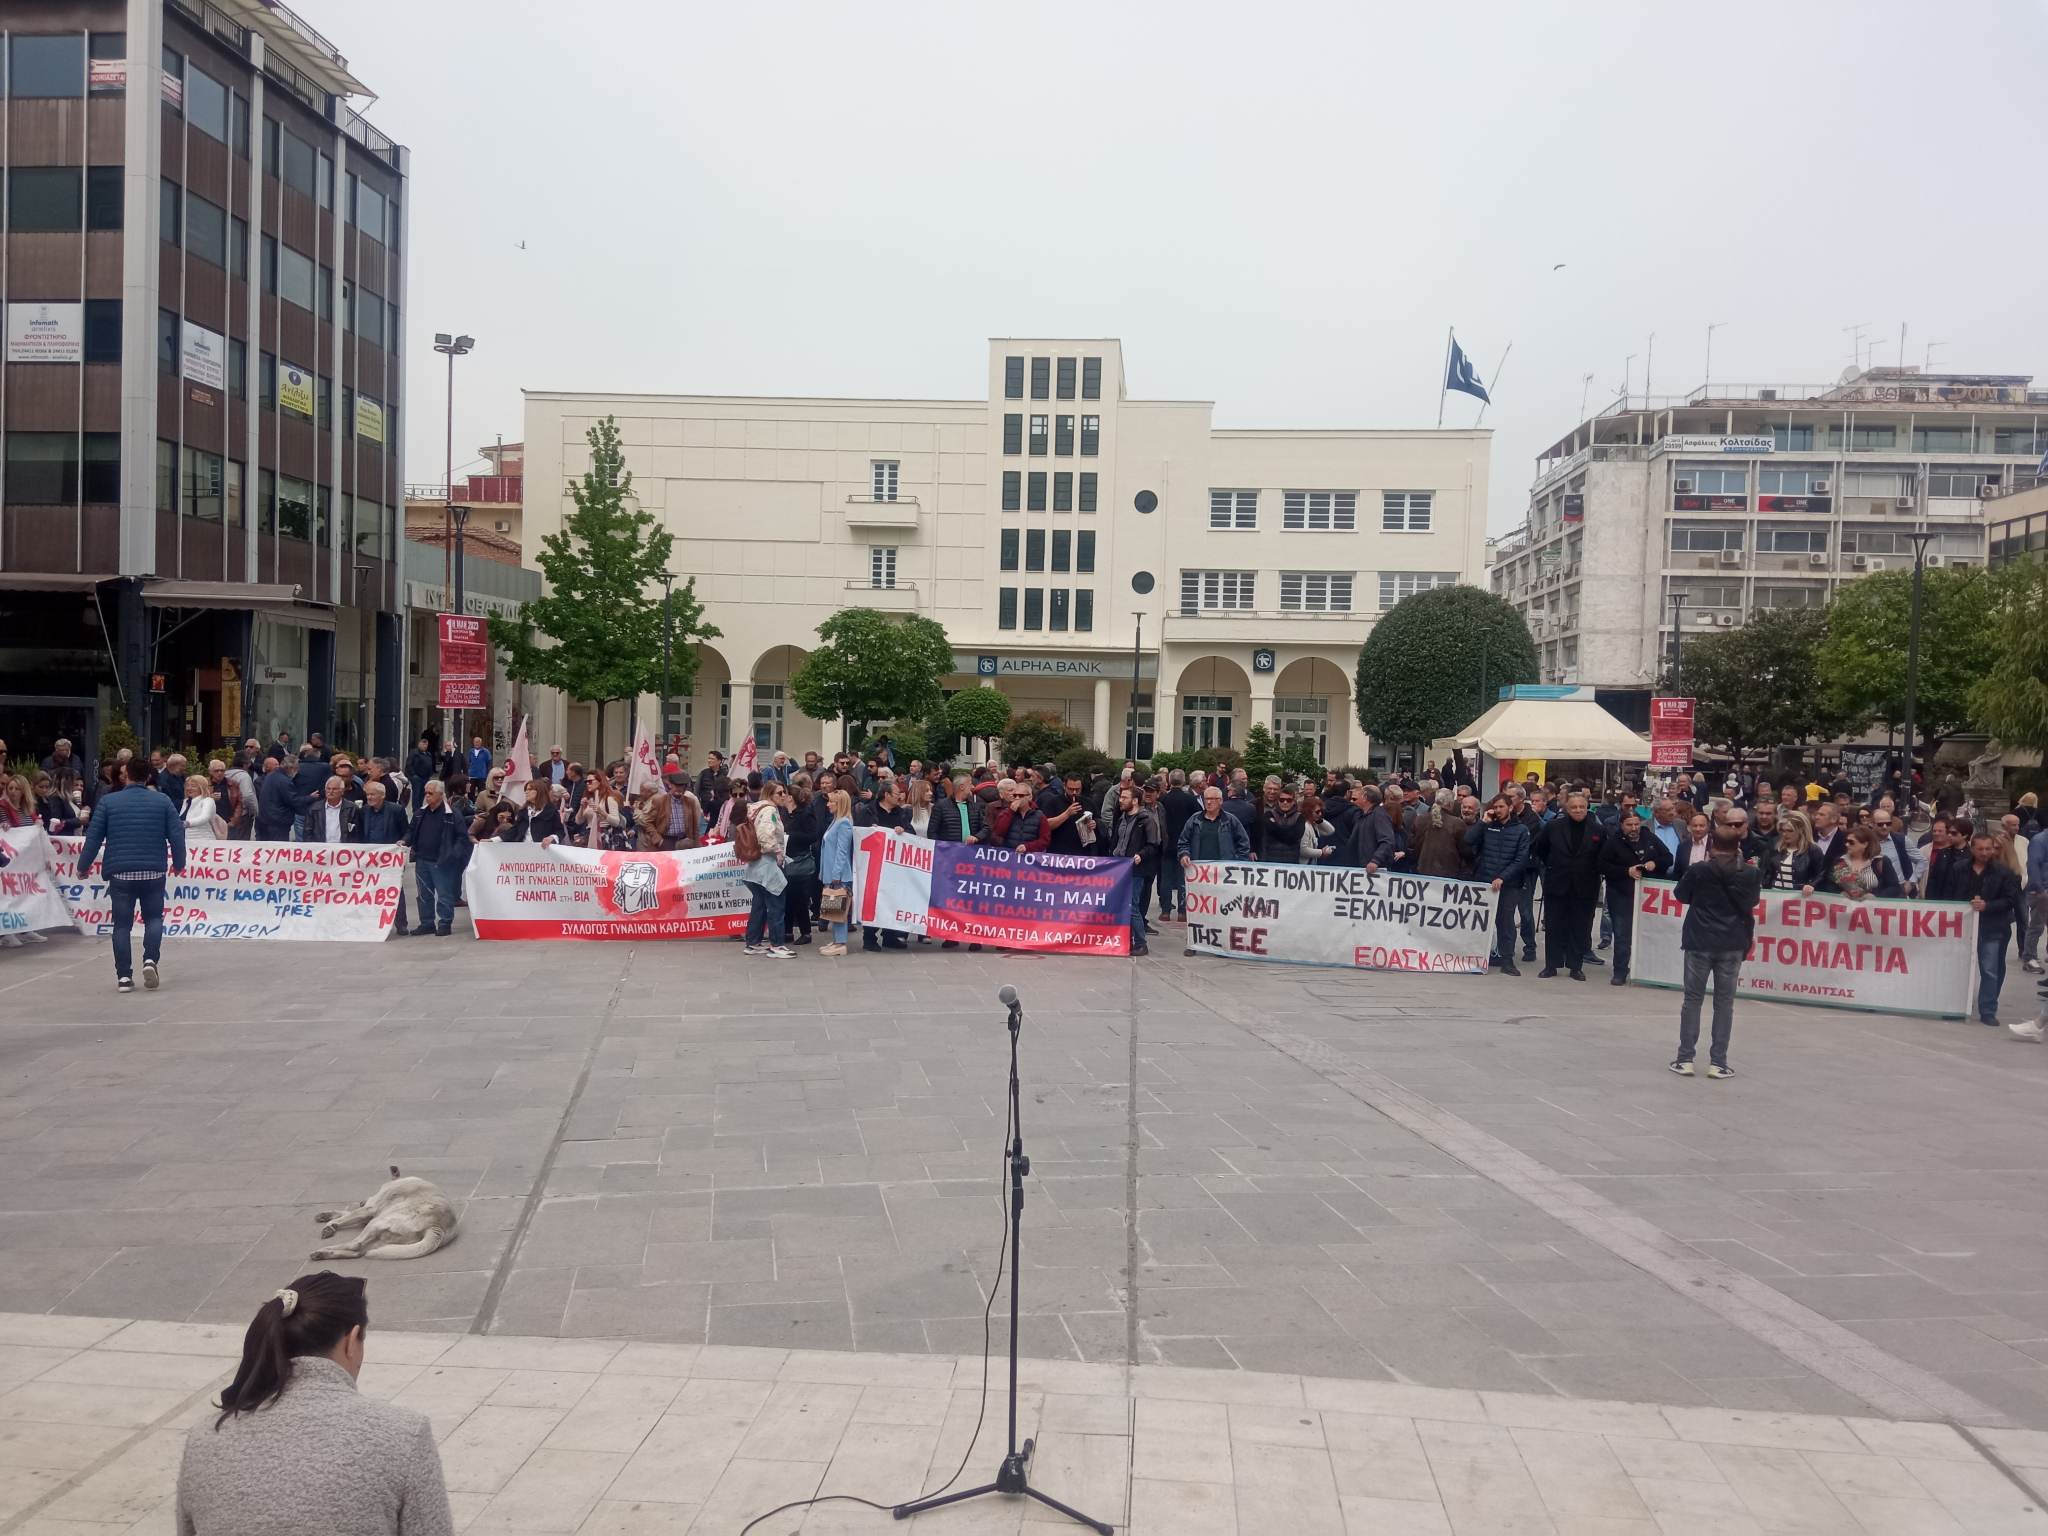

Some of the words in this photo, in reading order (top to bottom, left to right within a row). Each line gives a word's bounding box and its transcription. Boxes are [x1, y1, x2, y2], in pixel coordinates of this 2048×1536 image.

[1684, 439, 1718, 447] Ασφάλειες
[1720, 438, 1772, 448] Κολτσίδας
[1002, 660, 1052, 672] ALPHA
[1056, 660, 1102, 674] BANK
[252, 848, 404, 870] ΣΥΜΒΑΣΙΟΥΧΩΝ
[702, 851, 736, 864] ΕΚΜΕΤΑΛΛΕ
[727, 859, 746, 867] ΠΟΛΕ
[974, 847, 1010, 862] ΑΠΟ
[1017, 853, 1036, 865] ΤΟ
[1041, 855, 1096, 871] ΣΙΚΑΓΟ
[499, 862, 556, 874] ΑΝΥΠΟΧΩΡΗΤΑ
[560, 863, 608, 875] ΠΑΛΕΥΟΥΜΕ
[860, 831, 886, 922] 1
[885, 839, 894, 862] Η
[900, 842, 932, 872] ΜΑΗ
[955, 862, 976, 875] ΩΣ
[981, 865, 1010, 880] ΤΗΝ
[1016, 870, 1115, 888] ΚΑΙΣΑΡΙΑΝΗ
[338, 870, 380, 888] ΤΩΝ
[496, 875, 511, 886] ΓΙΑ
[514, 876, 525, 886] ΤΗ
[528, 876, 569, 886] ΓΥΝΑΙΚΕΙΑ
[572, 876, 608, 887] ΙΣΟΤΙΜΙΑ
[1186, 864, 1218, 884] ΟΧΙ
[1223, 866, 1270, 886] ΣΤΙΣ
[1274, 870, 1380, 896] ΠΟΛΙΤΙΚΕΣ
[1388, 878, 1430, 902] ΠΟΥ
[1442, 884, 1488, 907] ΜΑΣ
[174, 886, 200, 900] ΑΠΟ
[205, 887, 228, 902] ΤΙΣ
[516, 890, 556, 902] ΕΝΑΝΤΙΑ
[574, 891, 590, 902] ΒΙΑ
[686, 890, 720, 902] ΣΠΕΡΝΟΥΝ
[722, 889, 731, 898] ΕΕ
[957, 880, 1006, 898] ΖΗΤΩ
[1014, 886, 1026, 900] Η
[1034, 889, 1054, 906] 1η
[1064, 891, 1106, 906] ΜΑΗ
[275, 905, 315, 918] ΤΡΙΕΣ
[699, 901, 716, 911] ΝΑΤΟ
[718, 901, 723, 909] &
[725, 898, 753, 908] ΚΥΒΕΡΝ
[946, 898, 974, 912] ΚΑΙ
[979, 901, 989, 914] Η
[995, 904, 1038, 918] ΠΑΛΗ
[1058, 909, 1115, 924] ΤΑΞΙΚΗ
[1186, 892, 1217, 915] ΟΧΙ
[1242, 896, 1280, 920] ΚΑΠ
[1334, 898, 1490, 932] ΞΕΚΛΗΡΙΖΟΥΝ
[1642, 887, 1683, 918] ΖΗ
[1782, 900, 1964, 938] ΕΡΓΑΤΙΚΗ
[163, 924, 281, 938] ΑΘΑΡΙΣΤΡΙΩΝ
[562, 922, 608, 935] ΣΥΛΛΟΓΟΣ
[610, 922, 658, 934] ΓΥΝΑΙΚΩΝ
[659, 919, 716, 934] ΚΑΡΔΙΤΣΑΣ
[896, 910, 958, 932] ΕΡΓΑΤΙΚΑ
[964, 922, 1038, 942] ΣΩΜΑΤΕΙΑ
[1044, 927, 1121, 947] ΚΑΡΔΙΤΣΑΣ
[1188, 922, 1222, 948] ΤΗΣ
[1751, 978, 1776, 991] ΚΕΝ.
[1783, 982, 1856, 999] ΚΑΡΔΙΤΣΑΣ
